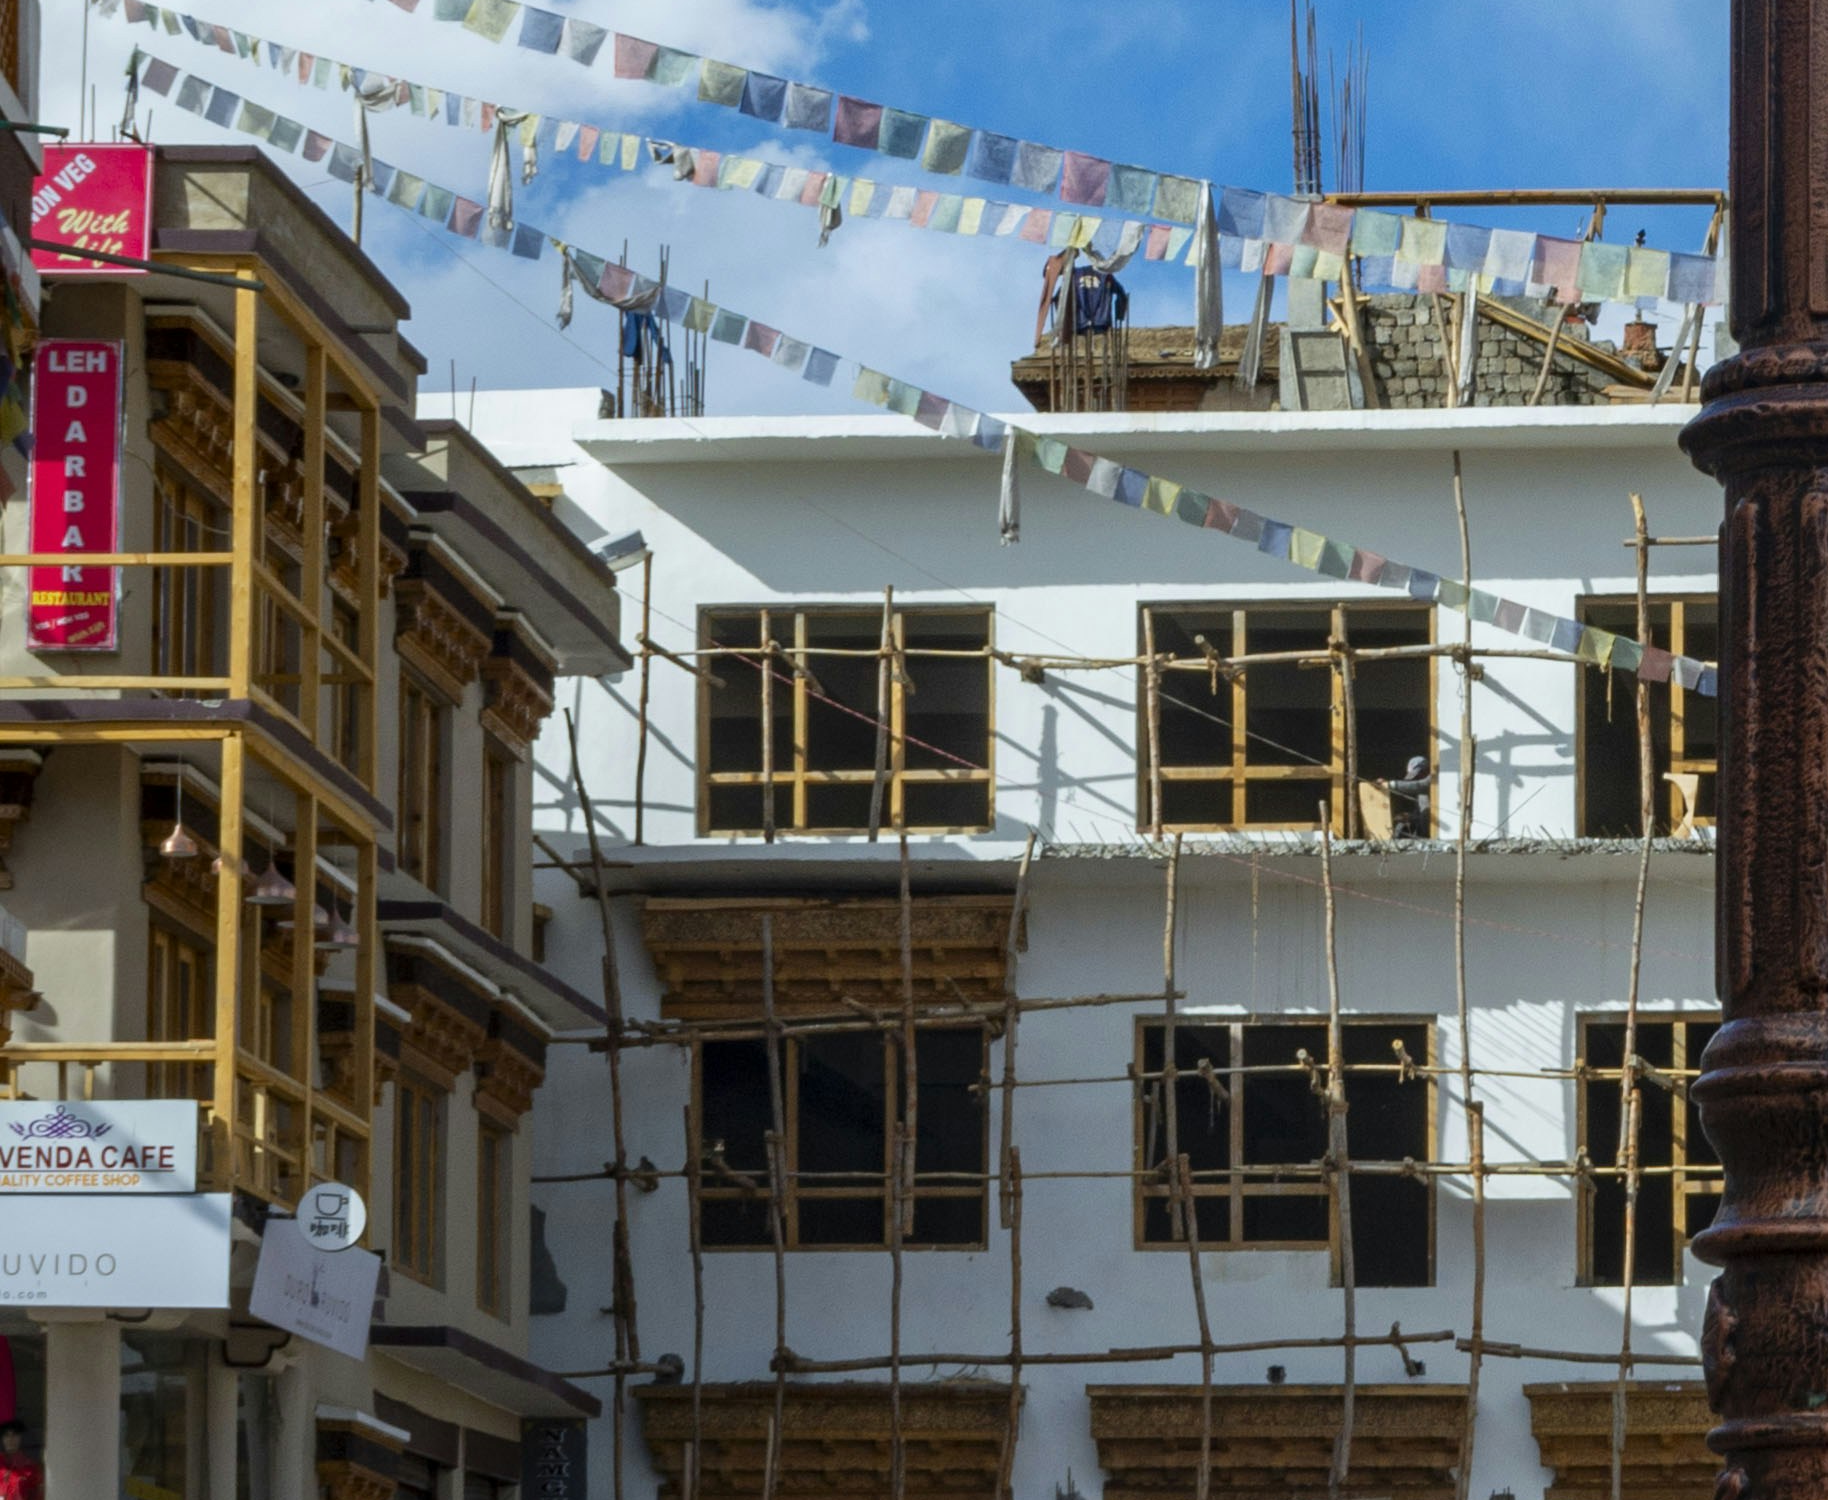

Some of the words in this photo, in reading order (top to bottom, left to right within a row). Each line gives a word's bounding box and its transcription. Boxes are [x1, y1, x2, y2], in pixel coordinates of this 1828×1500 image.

[53, 153, 96, 191] VEG
[57, 207, 130, 234] With
[48, 350, 106, 373] LEH
[62, 385, 88, 583] DARBAR
[31, 590, 110, 606] RESTAURANT
[100, 1145, 175, 1169] CAFE
[44, 1174, 99, 1187] COFFEE
[102, 1174, 141, 1187] SHOP
